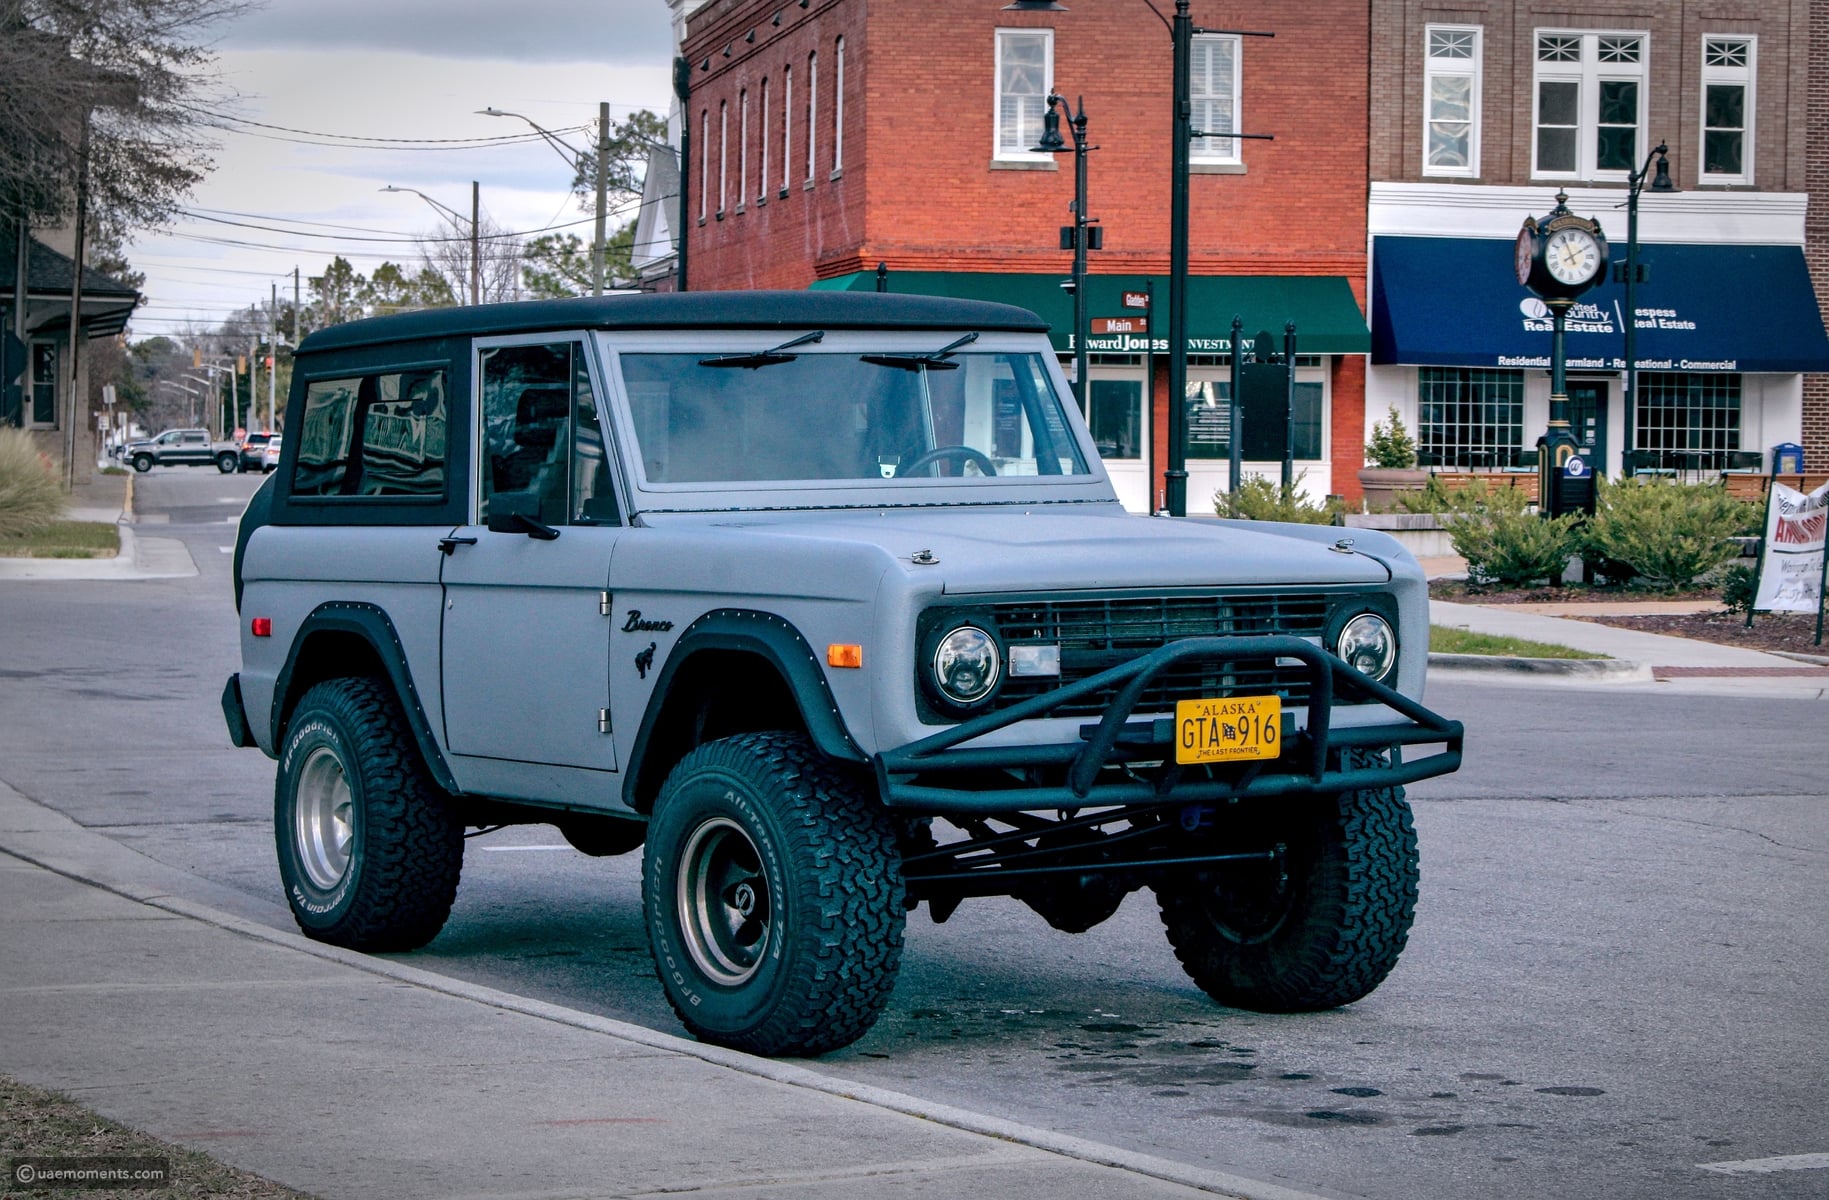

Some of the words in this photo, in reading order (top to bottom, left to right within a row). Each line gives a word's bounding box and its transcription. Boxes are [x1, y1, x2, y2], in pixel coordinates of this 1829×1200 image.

[1569, 302, 1597, 312] nited
[1634, 308, 1677, 318] espess
[1106, 319, 1132, 332] Main
[1523, 321, 1554, 332] Rea
[1565, 321, 1614, 333] Estate
[1659, 319, 1697, 330] Estate
[1498, 356, 1551, 366] Residential
[1565, 358, 1604, 368] armland
[1680, 359, 1737, 370] Commercial
[621, 609, 674, 632] Bronco
[1202, 703, 1256, 716] ALASKA
[1182, 717, 1220, 749] GTA
[1238, 714, 1276, 746] 916
[1199, 749, 1210, 757] THE
[1212, 748, 1228, 756] LAST
[1229, 746, 1258, 755] FRONTIER
[724, 790, 783, 911] All-Terrain
[653, 856, 702, 1007] BFGoodrich
